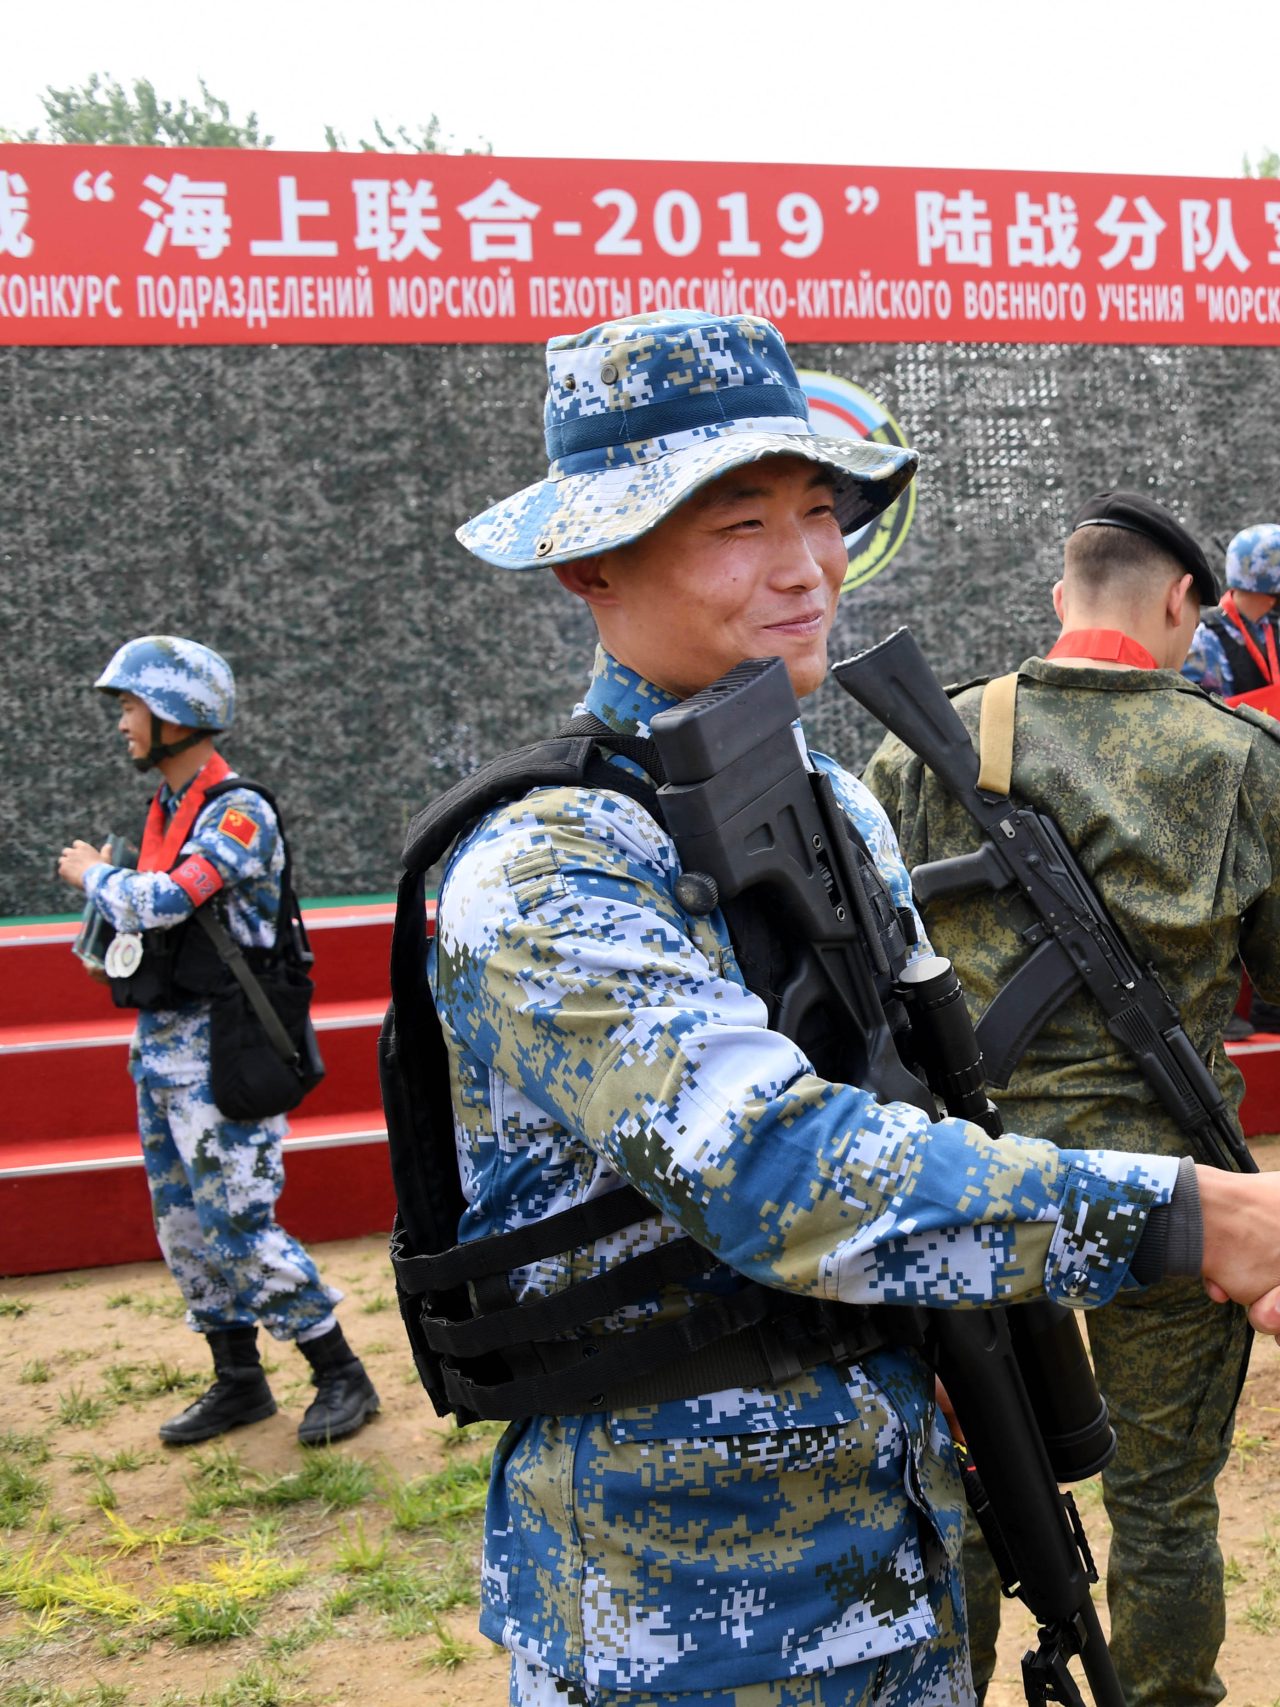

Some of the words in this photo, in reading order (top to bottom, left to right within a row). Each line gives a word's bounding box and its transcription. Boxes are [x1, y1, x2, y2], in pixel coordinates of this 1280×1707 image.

[136, 266, 374, 328] ПОДРАЗДЕЛЕНИЙ
[388, 267, 516, 318] МОРСКОЙ
[529, 276, 632, 317] ПЕХОТЫ
[639, 268, 951, 319] РОССИЙСКО-КИТАЙСКОГО
[964, 280, 1086, 320] ВОЕННОГО
[1097, 283, 1184, 321] УЧЕНИЯ
